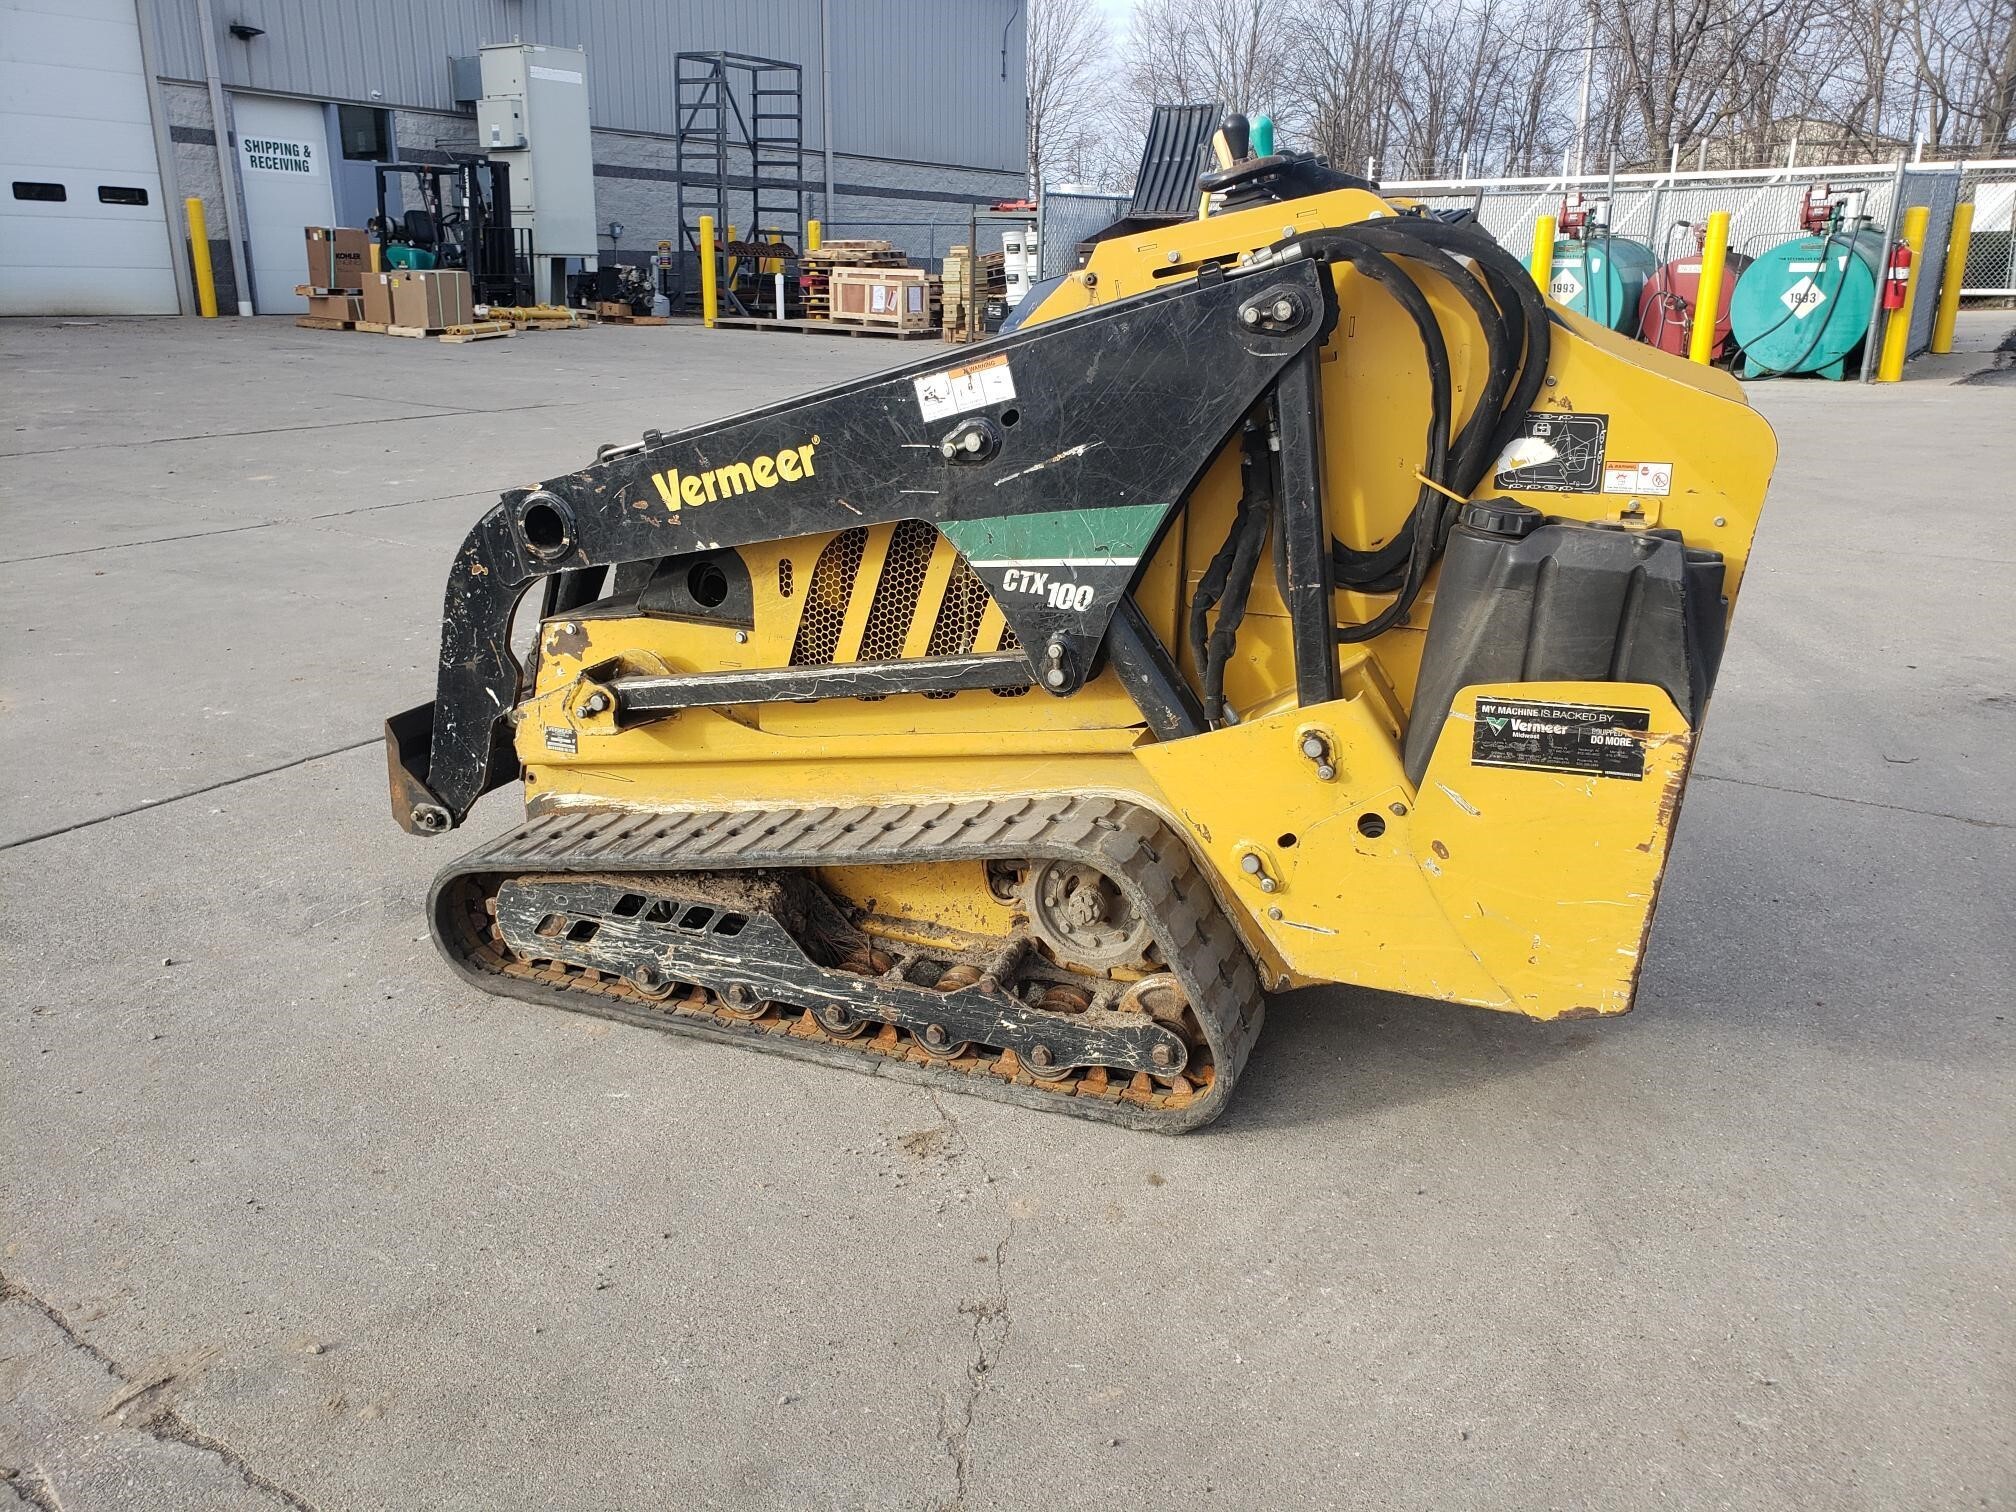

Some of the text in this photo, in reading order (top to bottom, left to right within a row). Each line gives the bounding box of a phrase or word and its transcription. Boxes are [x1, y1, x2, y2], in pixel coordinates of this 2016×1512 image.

[244, 139, 312, 158] SHIPPING &
[249, 155, 310, 172] RECEIVING
[335, 252, 361, 260] KOHLER
[1553, 283, 1575, 293] 1993
[968, 361, 996, 372] WARNING
[651, 443, 815, 512] Vermeer
[1002, 568, 1095, 612] CTX 100
[1481, 704, 1615, 723] MY MACHINE IS BACKED BY
[1510, 718, 1568, 735] Vermeer
[1512, 731, 1540, 740] Midwest
[1590, 735, 1634, 747] DO MORE.
